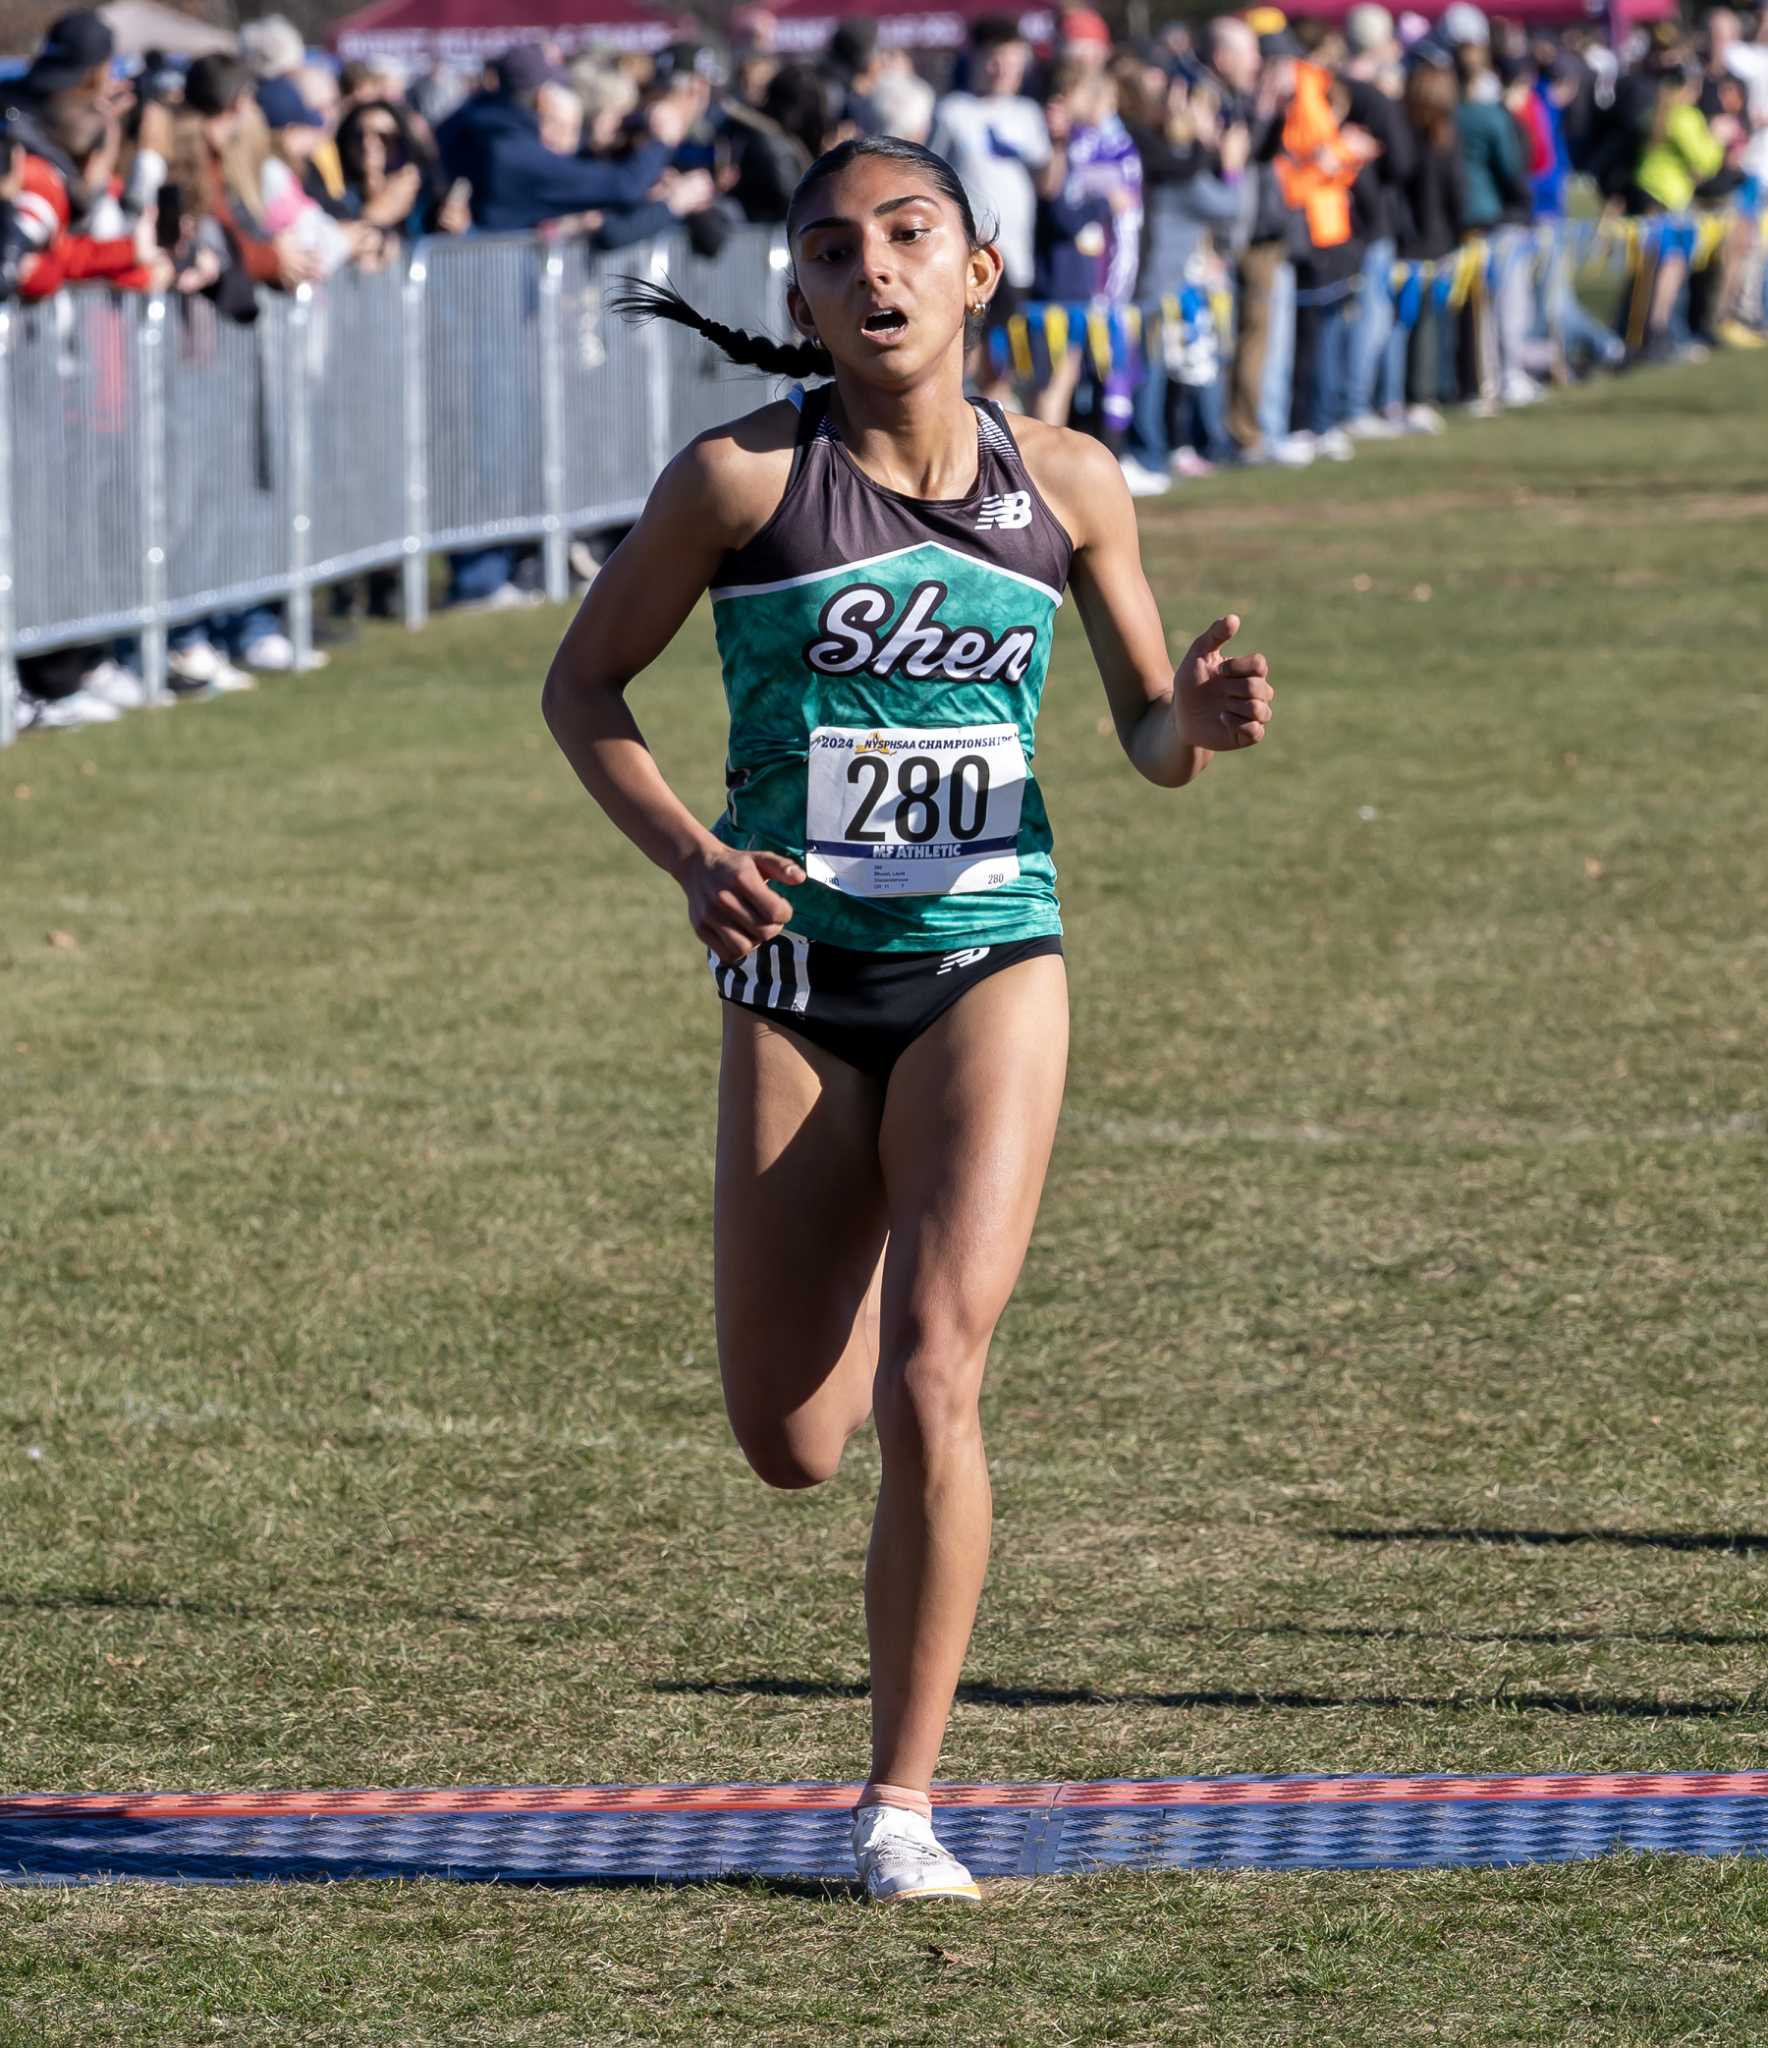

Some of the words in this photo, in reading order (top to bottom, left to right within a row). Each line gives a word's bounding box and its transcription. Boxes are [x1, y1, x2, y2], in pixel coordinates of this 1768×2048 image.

[975, 490, 1032, 530] NB
[803, 580, 1037, 686] Shen
[821, 737, 854, 749] 2024
[864, 738, 916, 750] NYSPHSAA
[844, 754, 990, 843] 280
[873, 845, 894, 858] MF
[896, 844, 961, 858] ATHLETIC
[987, 873, 1005, 885] 280
